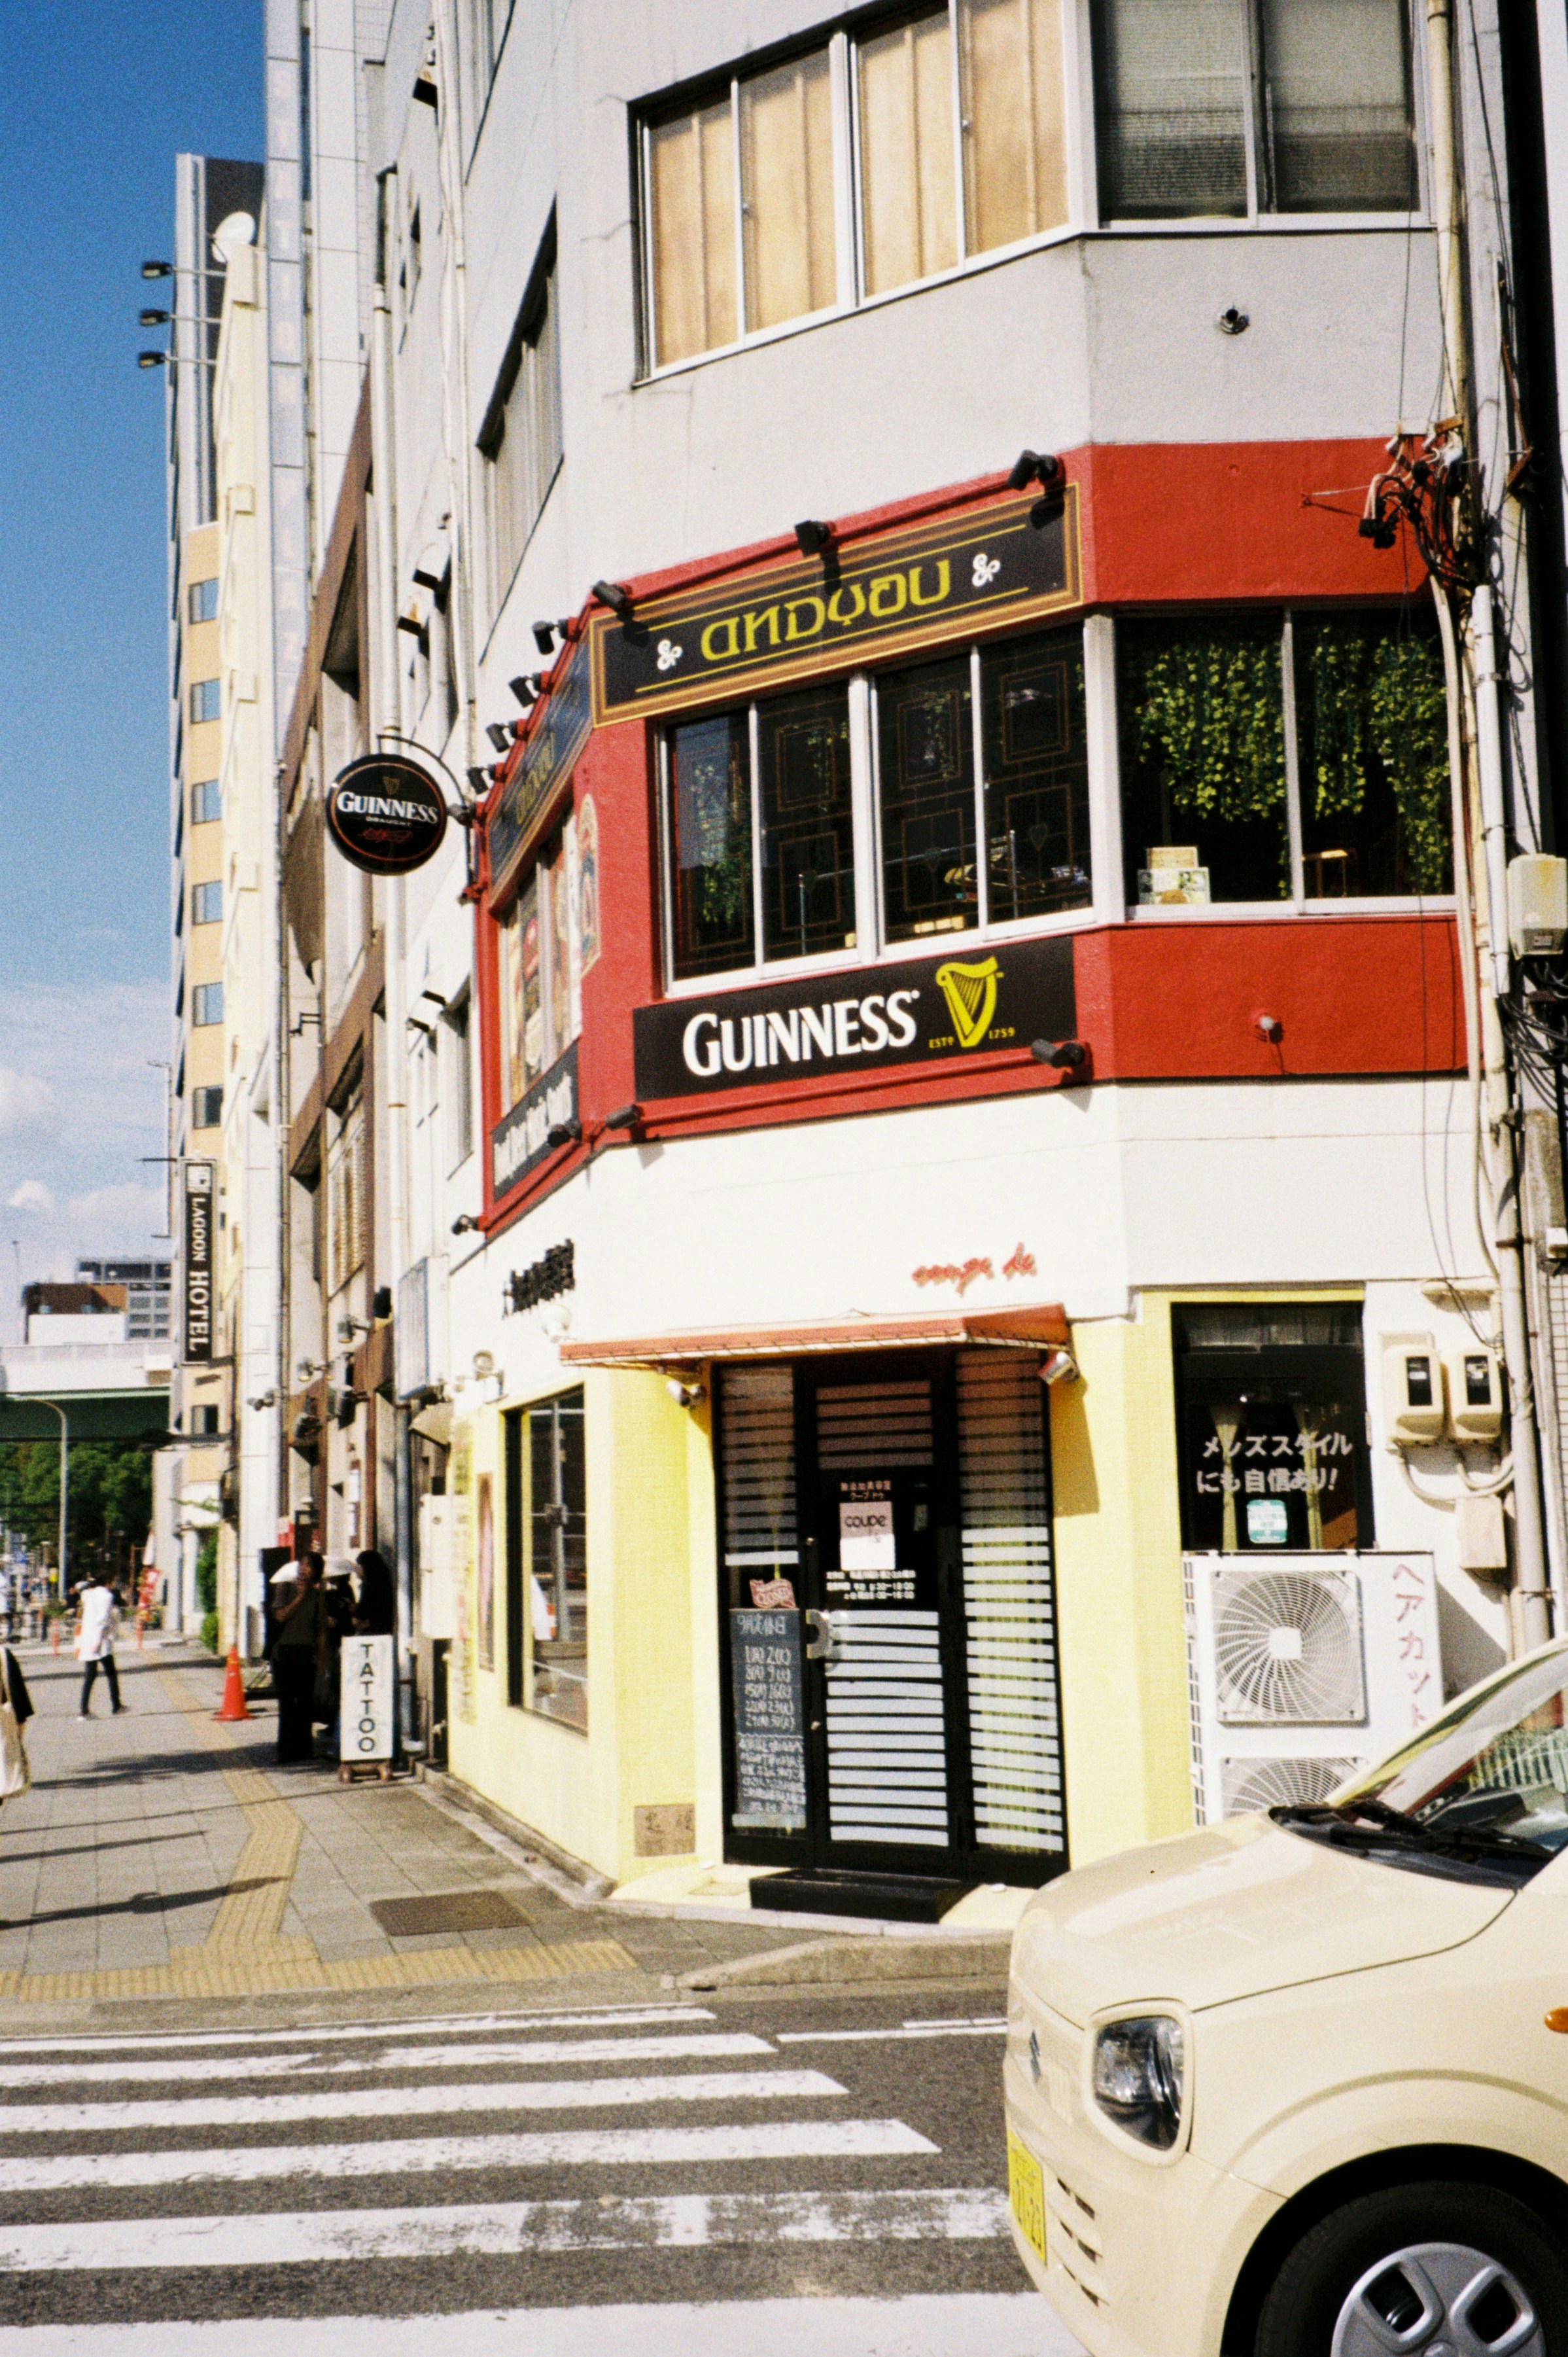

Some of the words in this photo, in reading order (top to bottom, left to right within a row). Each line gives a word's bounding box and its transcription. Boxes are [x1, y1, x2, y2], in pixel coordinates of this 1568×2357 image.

[337, 790, 438, 824] GUINNESS
[683, 989, 918, 1076] GUINNESS
[988, 1027, 1016, 1040] 1759
[192, 1197, 207, 1263] LAGOON
[188, 1272, 209, 1352] HOTEL
[1202, 1431, 1353, 1458] メンズスタイル
[1393, 1563, 1431, 1728] ヘアカット
[358, 1644, 375, 1752] TATTOO
